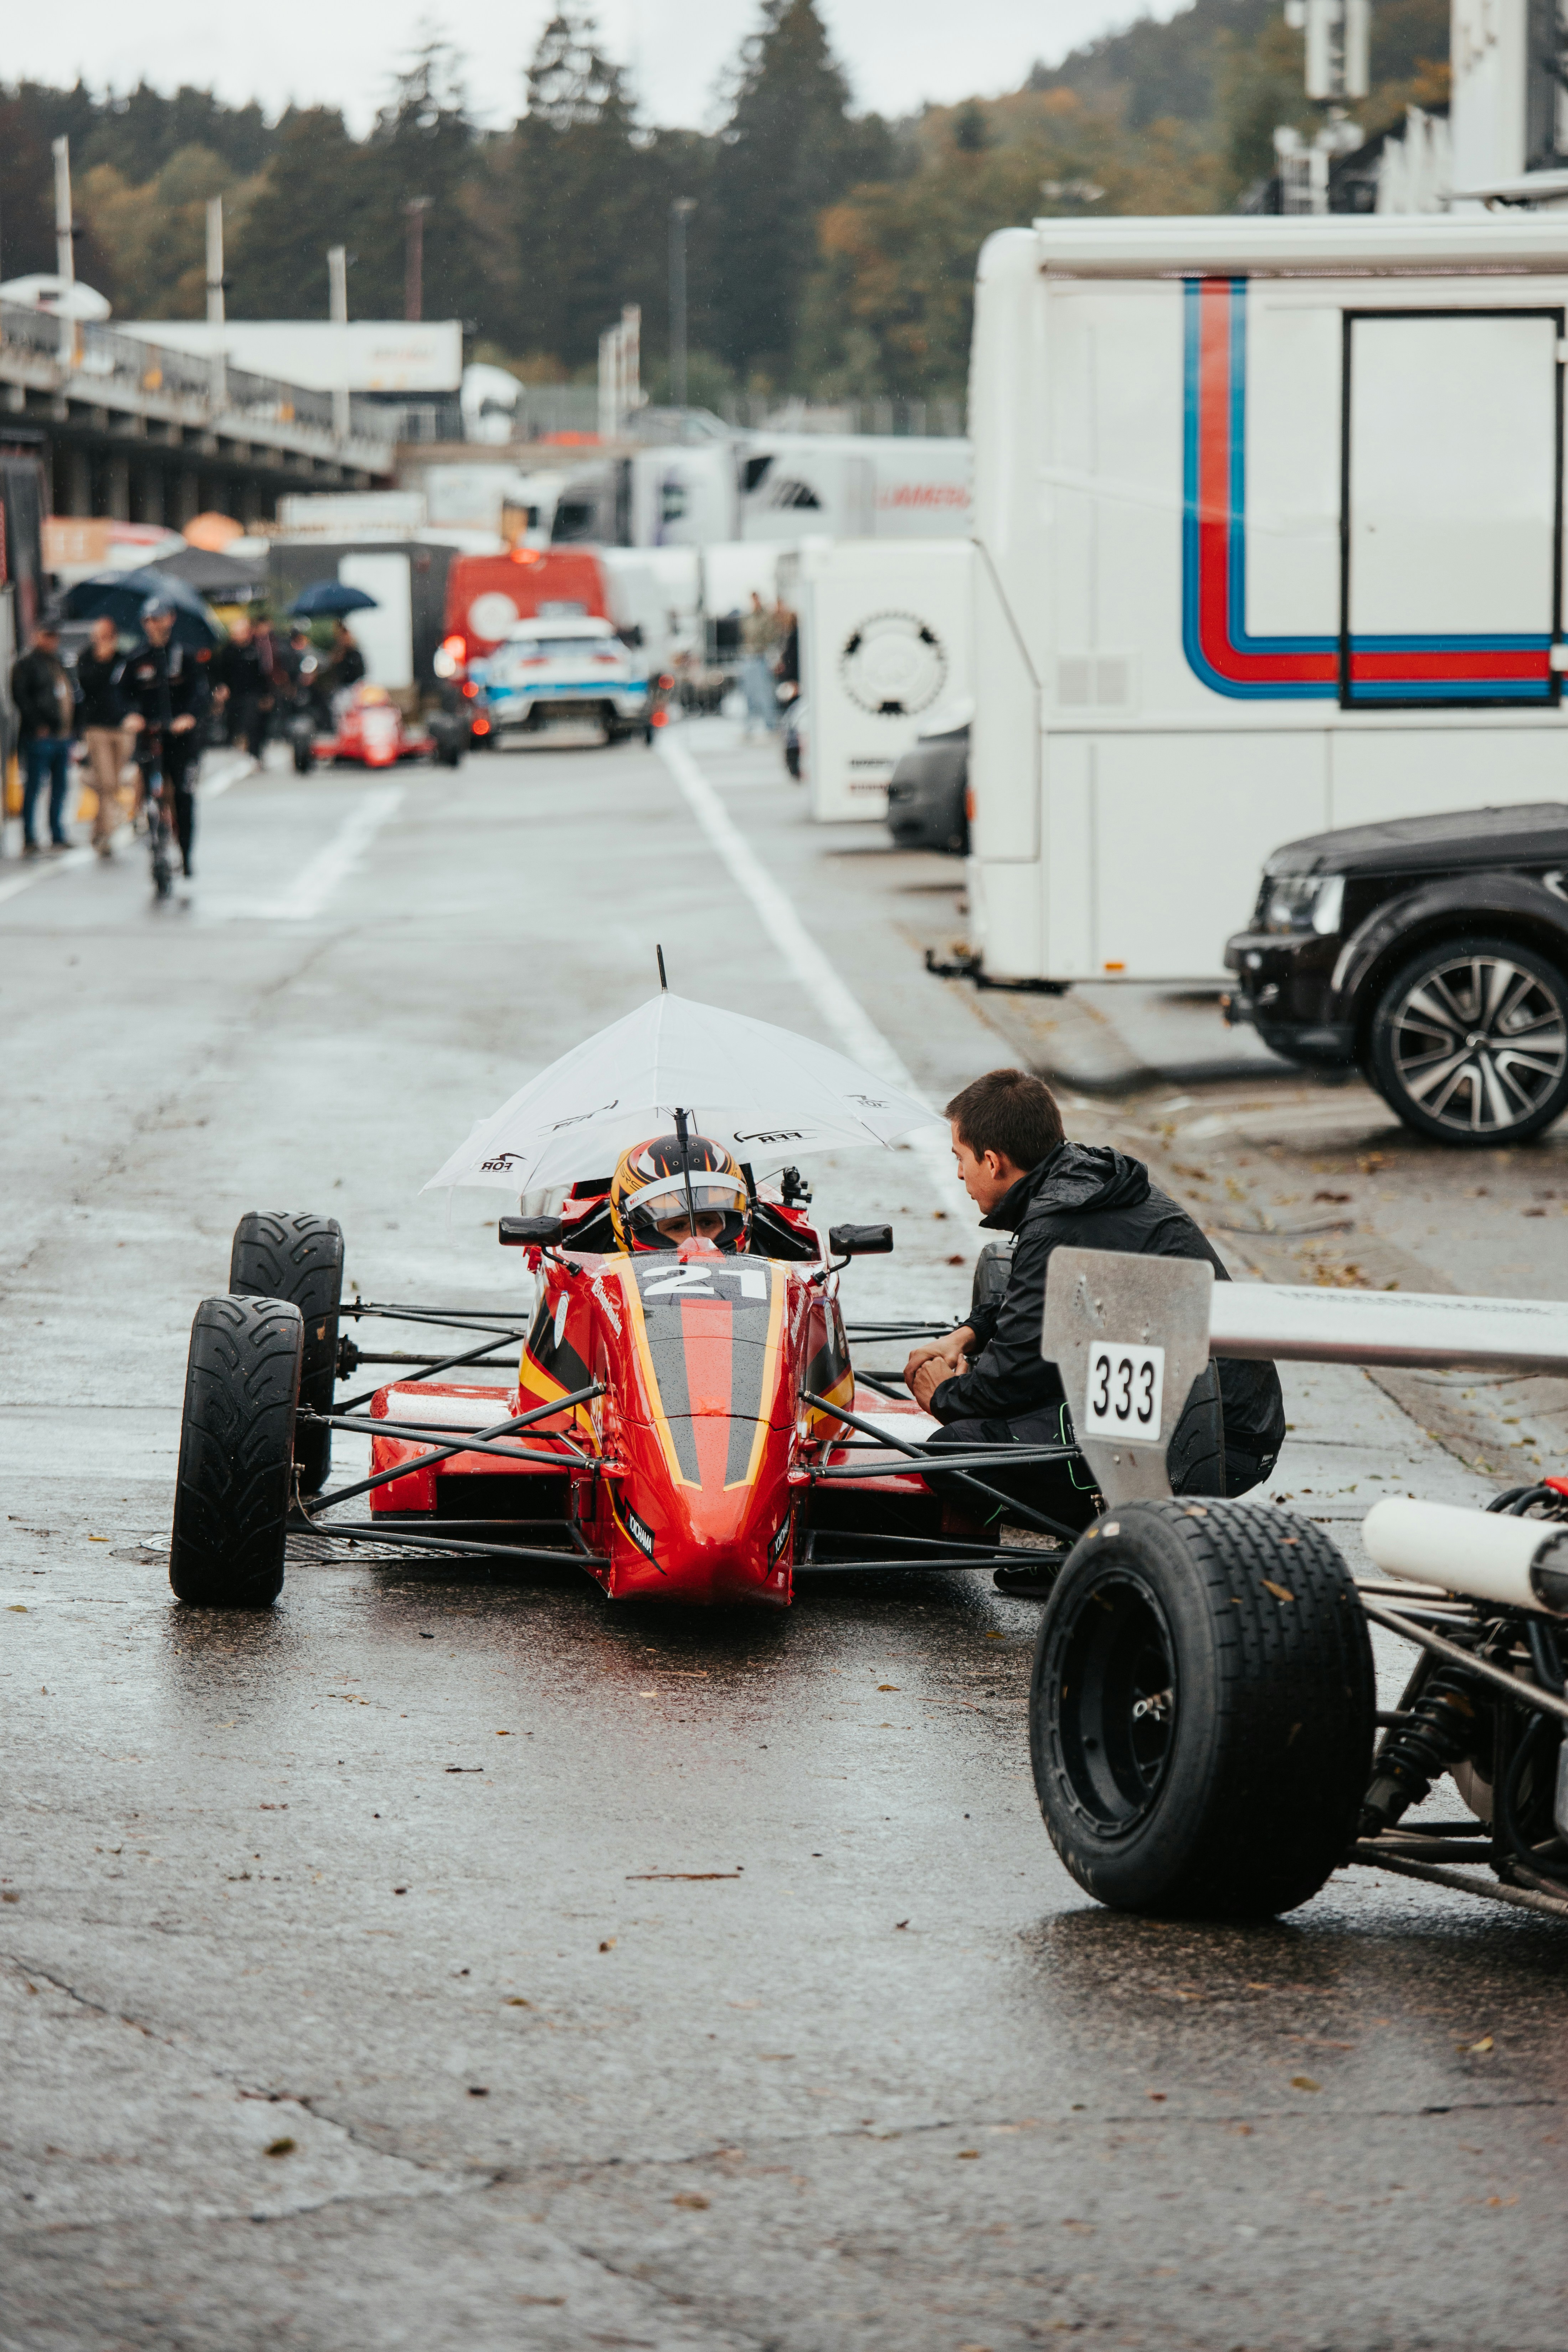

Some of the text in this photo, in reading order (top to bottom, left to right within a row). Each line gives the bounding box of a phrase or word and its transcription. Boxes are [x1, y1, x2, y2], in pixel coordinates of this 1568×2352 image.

[630, 1196, 639, 1205] BELL
[642, 1265, 767, 1300] 21
[1093, 1355, 1155, 1424] 333
[629, 1513, 652, 1554] YOKOHAMA
